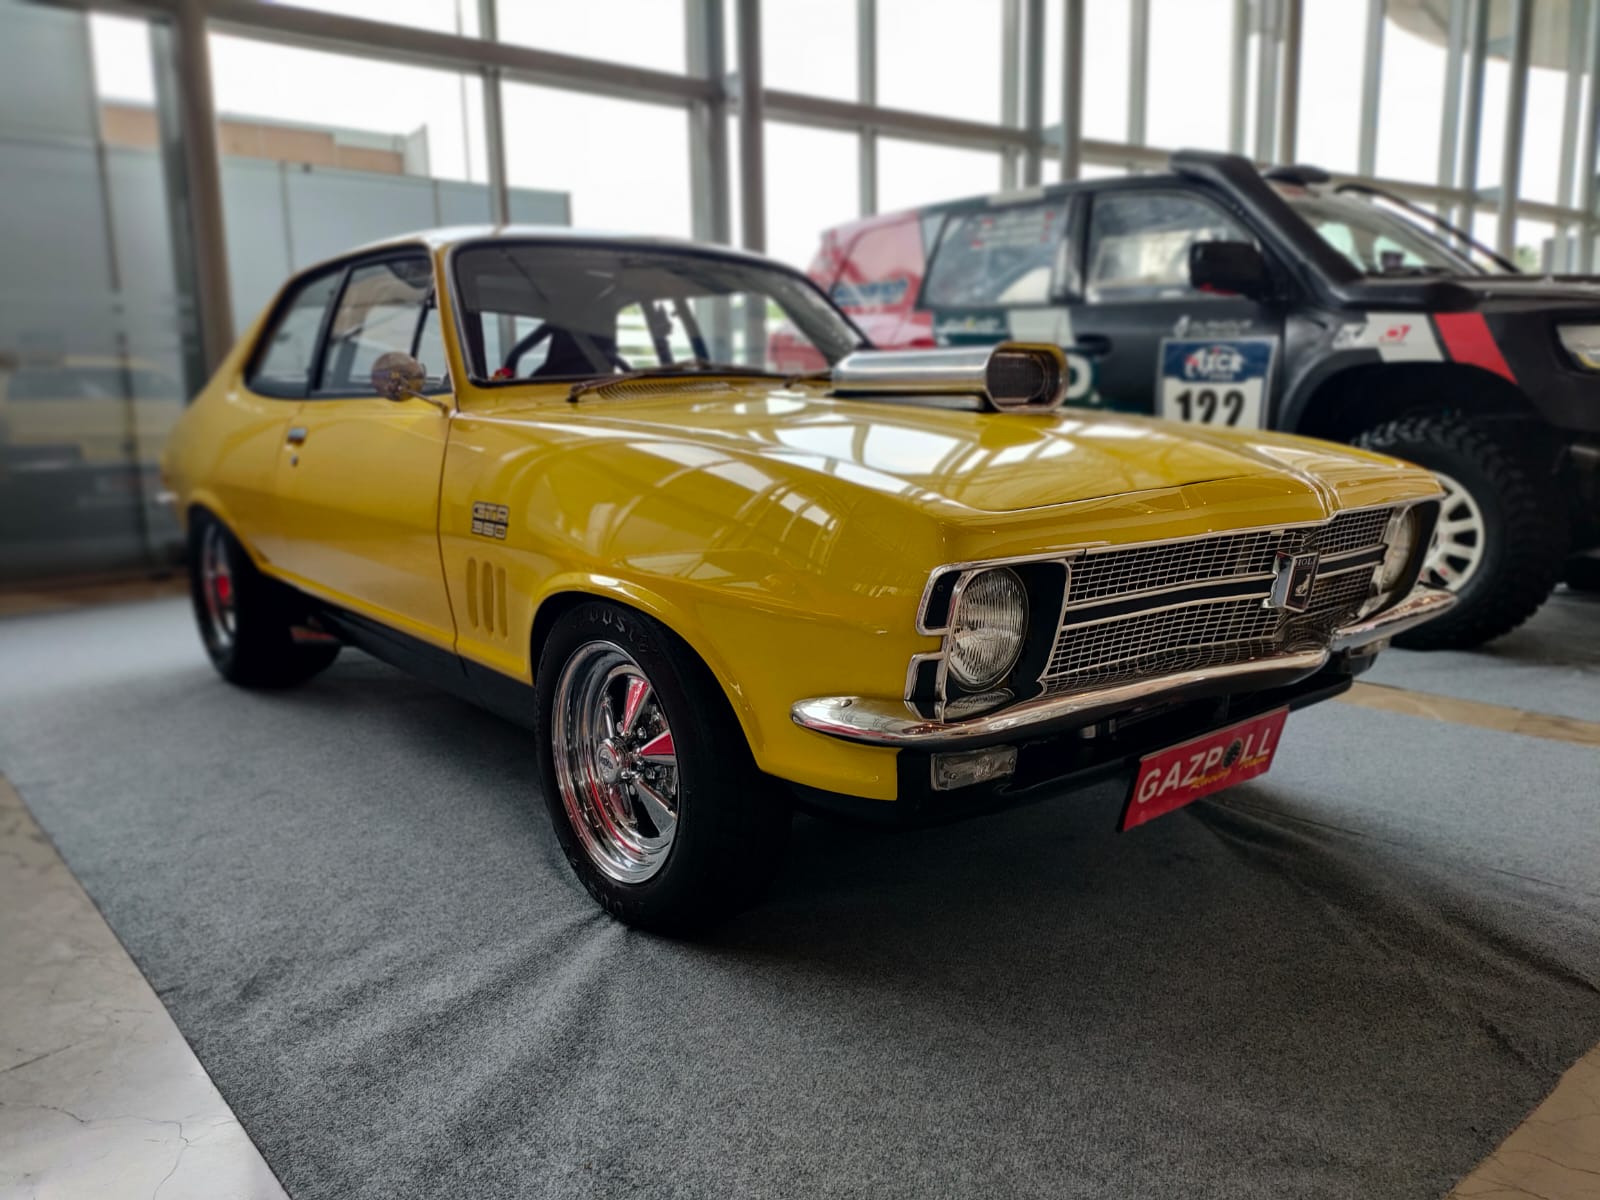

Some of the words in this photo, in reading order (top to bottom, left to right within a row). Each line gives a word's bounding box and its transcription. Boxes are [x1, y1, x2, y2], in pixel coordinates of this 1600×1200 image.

[1176, 389, 1245, 427] 122
[472, 500, 509, 524] GTR
[1137, 727, 1271, 804] GAZPOLL
